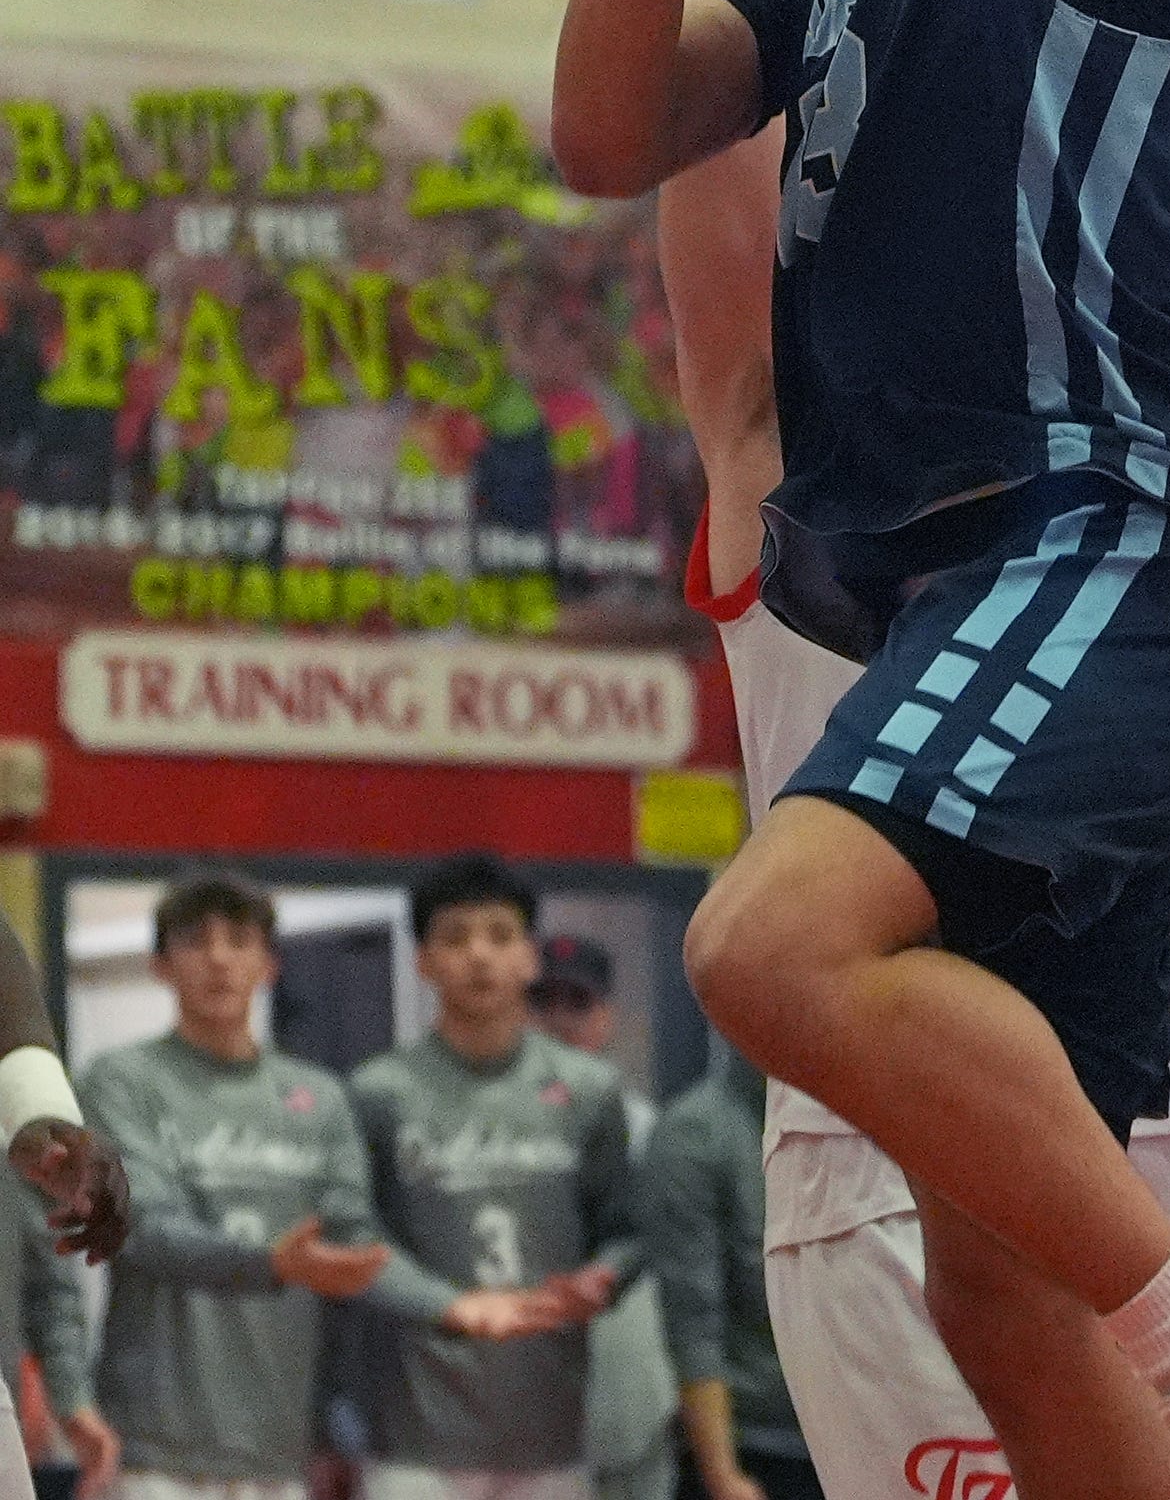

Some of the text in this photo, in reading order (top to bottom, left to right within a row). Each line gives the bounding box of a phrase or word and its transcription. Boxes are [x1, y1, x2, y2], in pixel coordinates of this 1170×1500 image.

[4, 86, 384, 212] BATTLE
[38, 264, 504, 422] FANS
[134, 561, 557, 634] CHAMPIONS
[98, 656, 668, 740] TRAINING ROOM
